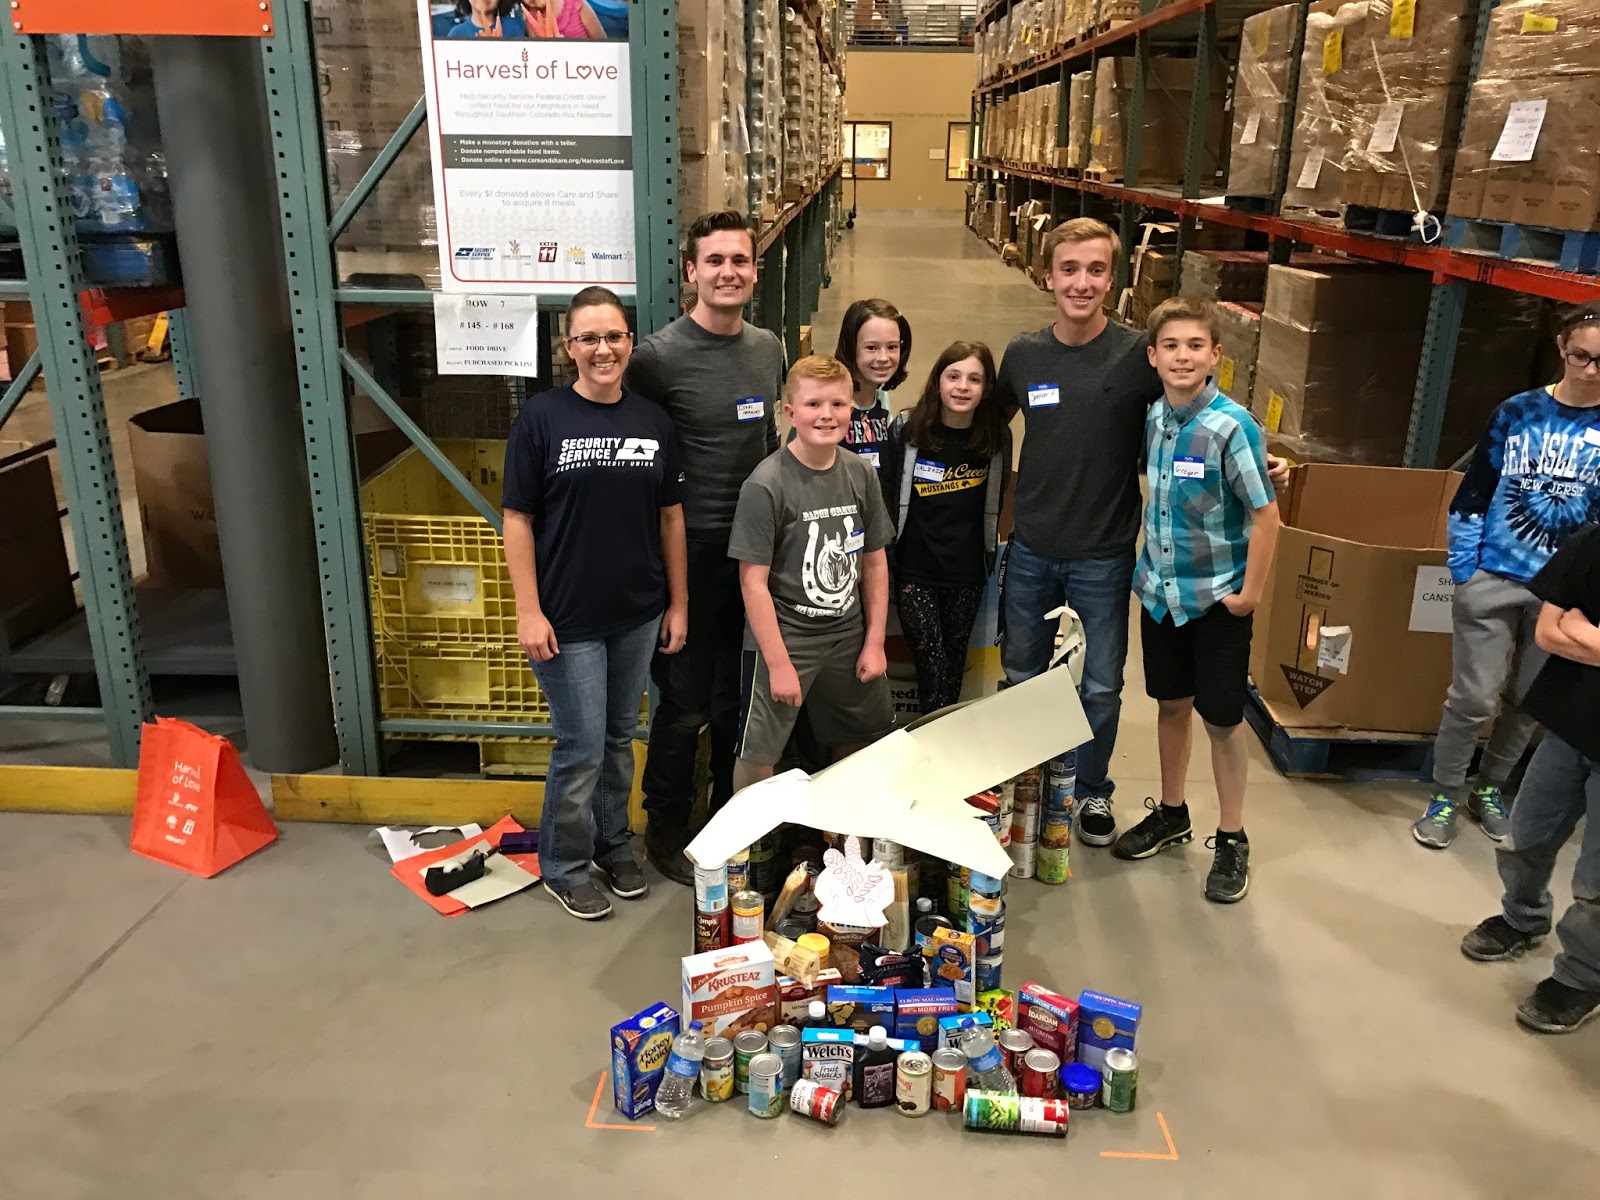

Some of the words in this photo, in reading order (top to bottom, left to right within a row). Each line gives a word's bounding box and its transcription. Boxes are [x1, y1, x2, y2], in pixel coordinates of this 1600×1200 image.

[446, 58, 528, 79] Harvest
[536, 60, 558, 79] of
[566, 61, 618, 80] Love
[459, 190, 482, 199] Every
[485, 190, 493, 198] $1
[495, 190, 528, 198] donated
[530, 190, 555, 198] allows
[558, 190, 576, 199] Care
[578, 190, 594, 199] and
[596, 190, 619, 199] Share
[513, 200, 543, 208] acquire
[592, 252, 623, 260] Walmart
[846, 418, 888, 444] GENIUS
[562, 437, 621, 452] SECURITY
[558, 449, 611, 466] SERVICE
[1536, 432, 1586, 479] ISLE
[556, 461, 591, 473] FEDERAL
[954, 463, 989, 478] Creek
[920, 481, 959, 493] MUSTANGS
[1521, 478, 1544, 491] NEW
[1548, 483, 1586, 496] JERSY
[830, 505, 857, 516] CREEK
[1298, 574, 1329, 586] PRODUCT
[1304, 589, 1331, 600] MEXICO
[1289, 672, 1323, 688] WATCH
[1293, 683, 1317, 695] STEP
[172, 775, 184, 785] of
[708, 971, 761, 992] KRUSTEAZ
[701, 999, 743, 1013] Pumpkin
[745, 992, 768, 1004] Spice
[1034, 997, 1050, 1010] MORE
[1028, 1009, 1058, 1027] IDAHOAN
[640, 1035, 670, 1063] Honey
[806, 1045, 852, 1058] Welch's
[645, 1047, 669, 1068] Maid
[814, 1070, 842, 1079] Snacks
